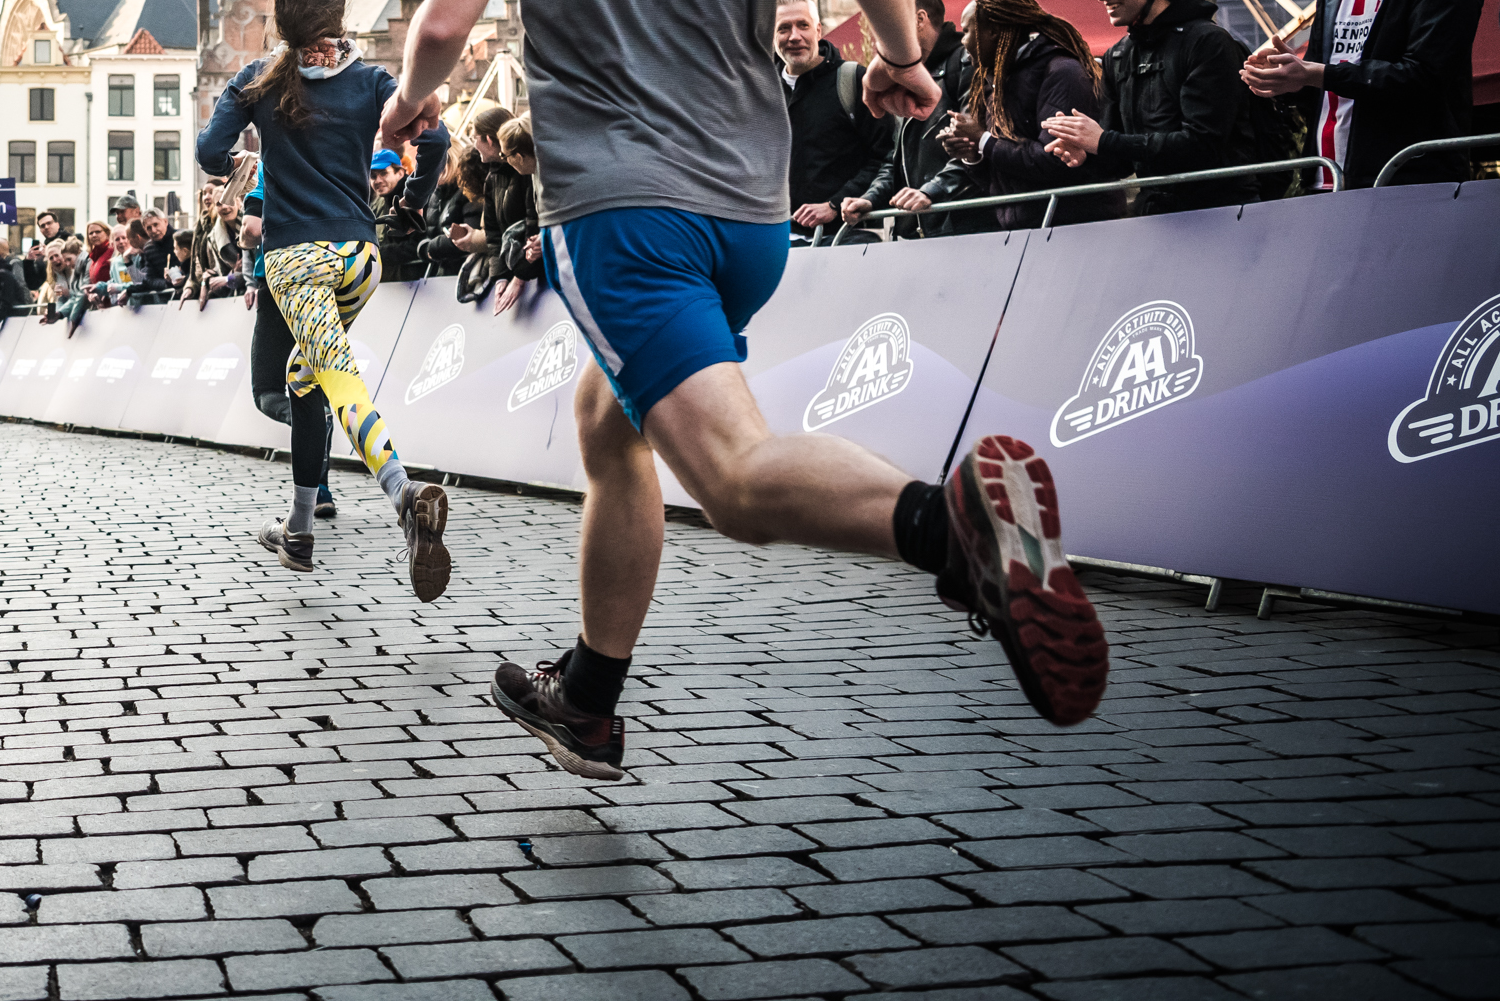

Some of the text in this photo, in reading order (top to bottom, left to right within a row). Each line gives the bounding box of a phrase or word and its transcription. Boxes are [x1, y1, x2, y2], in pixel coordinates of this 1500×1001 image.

[430, 343, 454, 376] AA
[536, 342, 564, 379] AA
[1097, 311, 1187, 371] ALL ACTIVITY DRINK
[1451, 337, 1478, 368] ALL
[422, 365, 454, 394] DRINK
[527, 366, 565, 399] DRINK
[847, 342, 889, 389] AA
[1109, 335, 1168, 394] AA
[833, 373, 894, 415] DRINK
[1094, 373, 1175, 426] DRINK
